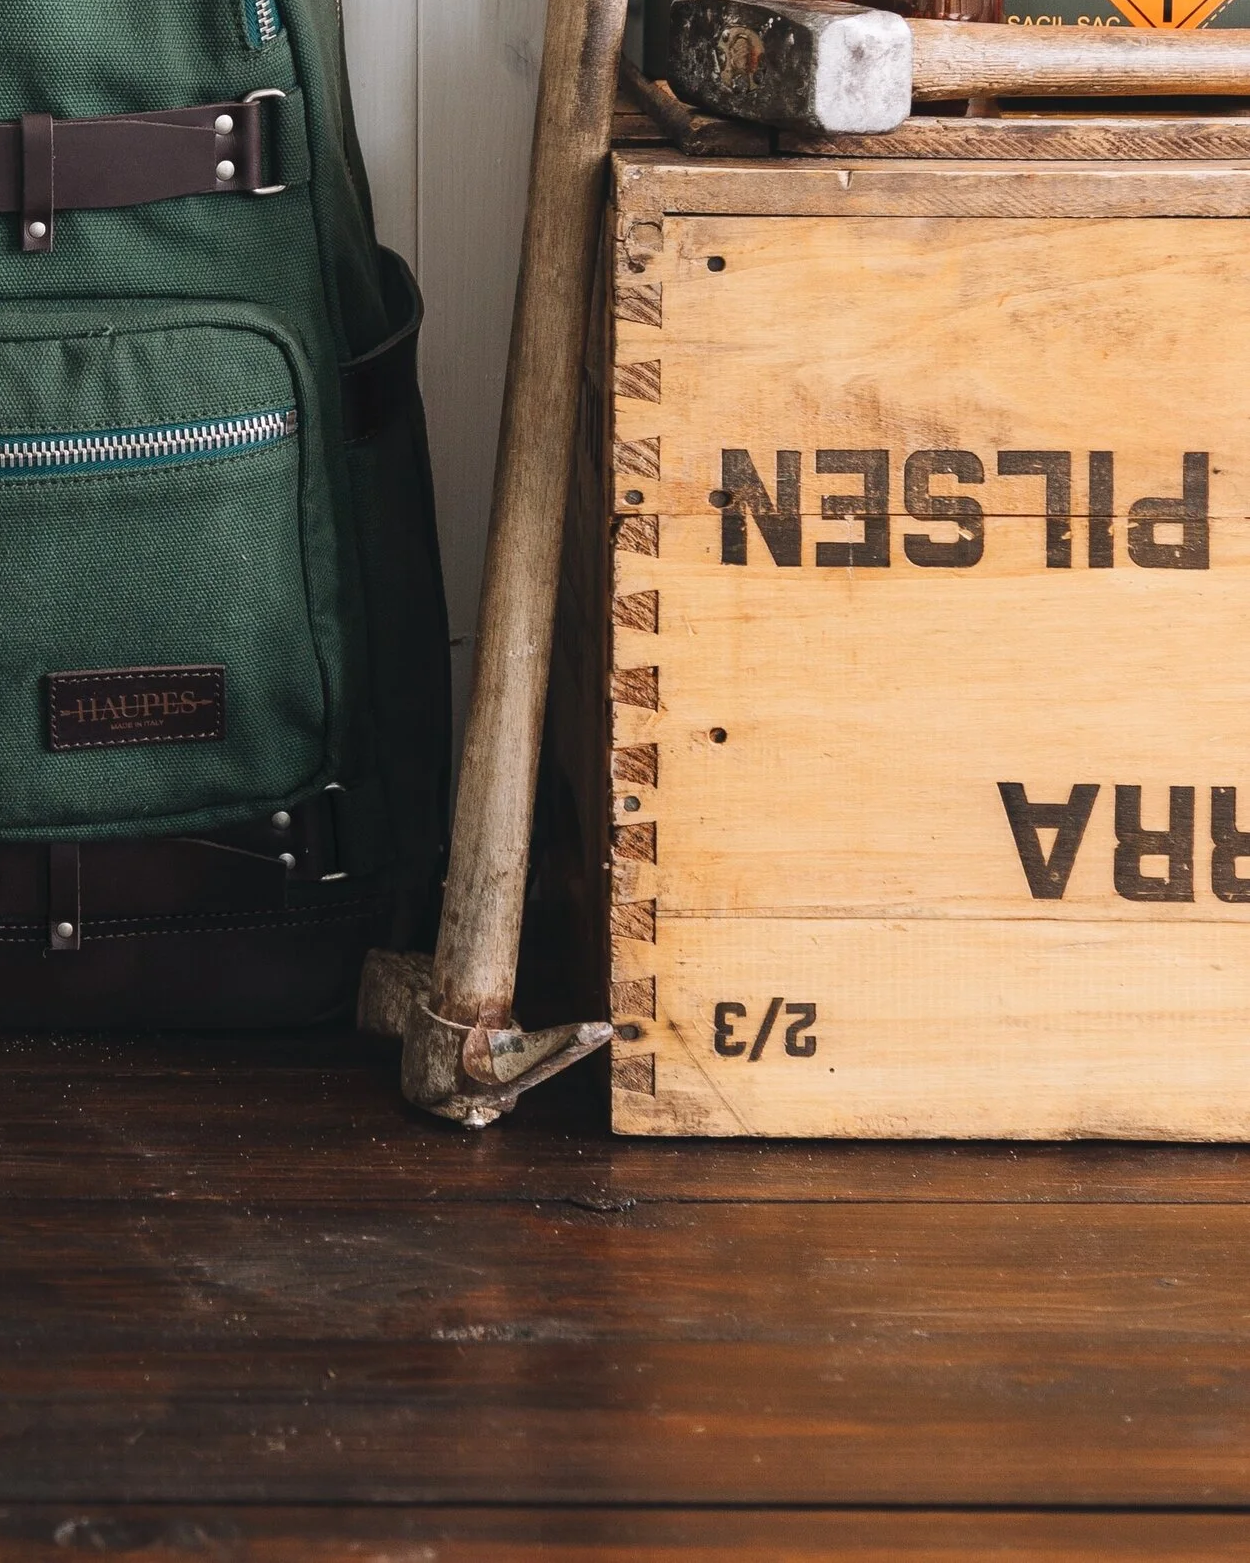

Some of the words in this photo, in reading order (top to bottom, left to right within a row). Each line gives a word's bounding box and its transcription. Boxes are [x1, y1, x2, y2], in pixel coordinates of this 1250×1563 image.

[721, 449, 1211, 569] PILSEN
[77, 690, 198, 723] HAUPES
[111, 721, 134, 730] MADE
[134, 721, 143, 729] IN
[144, 719, 165, 728] ITALY
[713, 997, 817, 1062] 2/3
